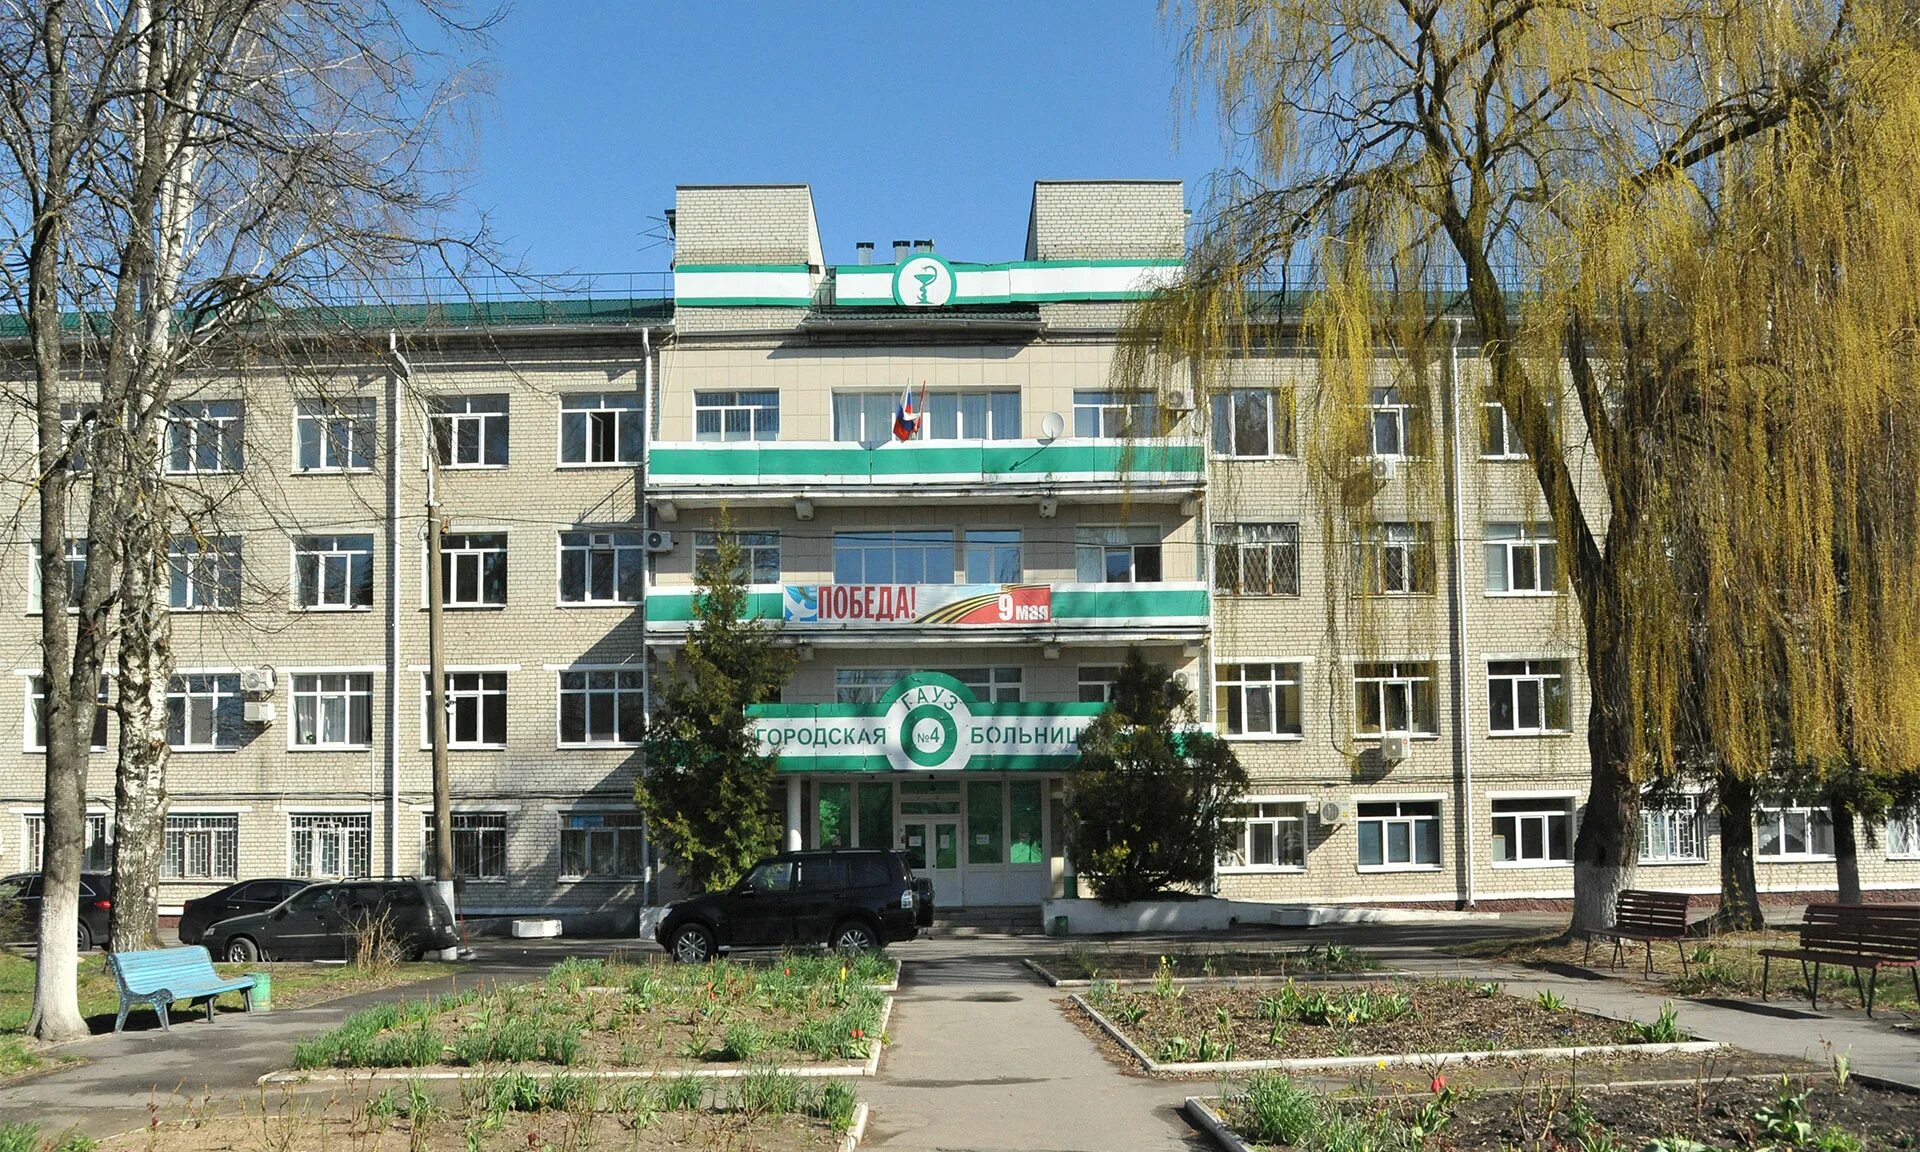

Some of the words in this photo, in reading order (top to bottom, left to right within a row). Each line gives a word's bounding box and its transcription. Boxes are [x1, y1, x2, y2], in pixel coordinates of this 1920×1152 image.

[818, 586, 916, 621] ПОБЕДА!
[998, 594, 1013, 621] 9
[1016, 605, 1049, 620] мая
[901, 687, 958, 711] ГАУЗ
[756, 728, 886, 748] ГОРОДСКАЯ
[971, 726, 1081, 744] БОЛЬНИЦ
